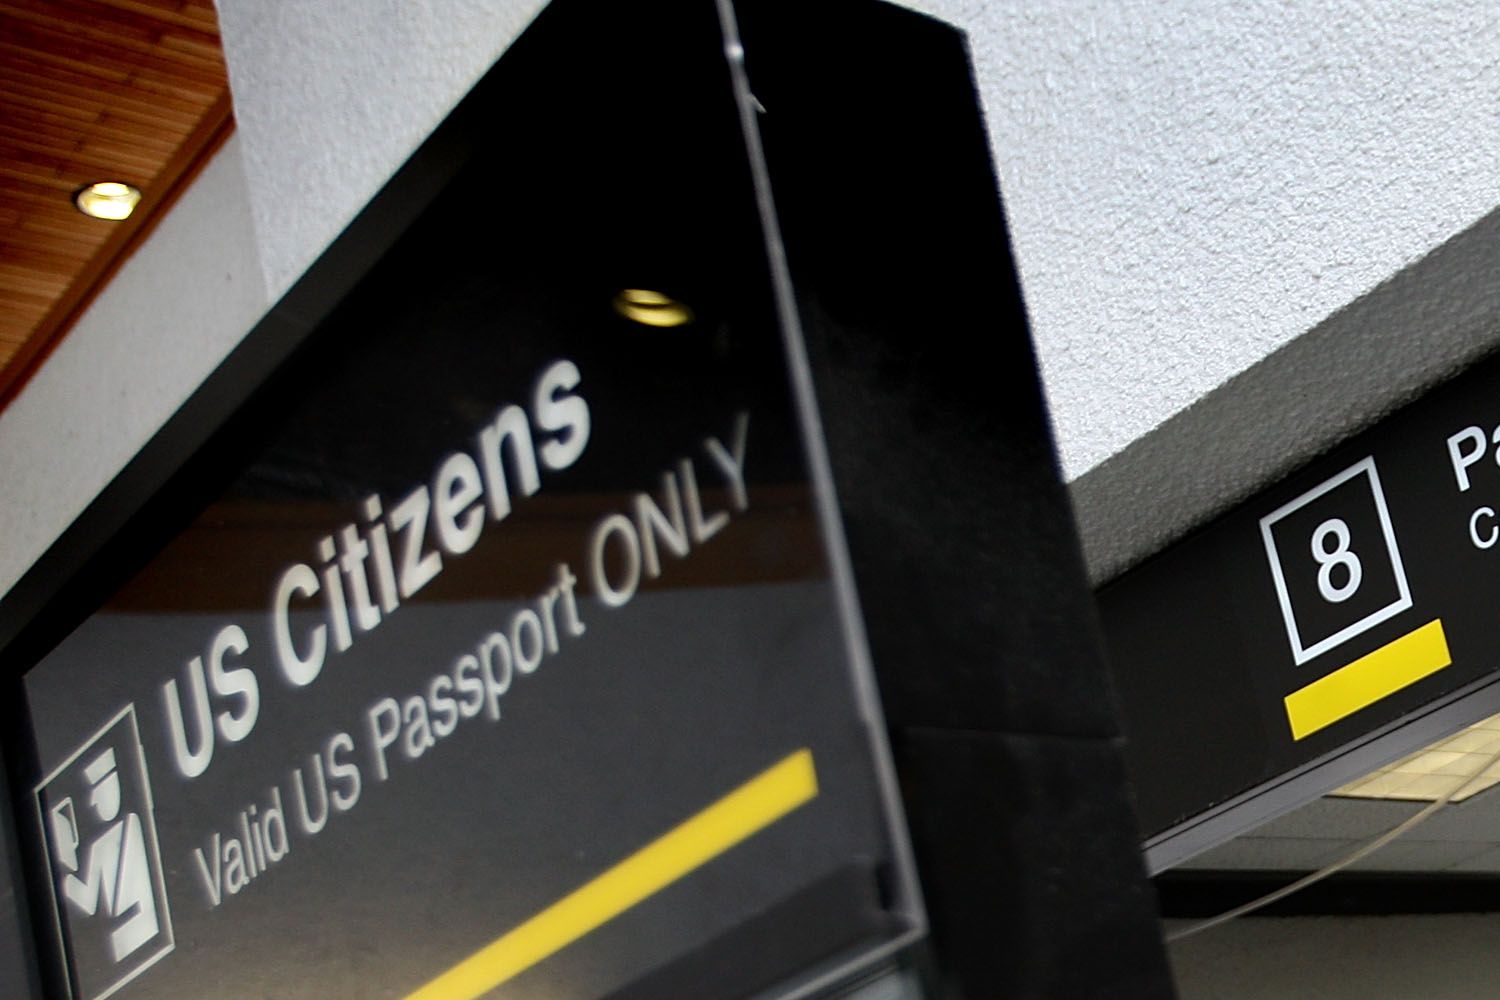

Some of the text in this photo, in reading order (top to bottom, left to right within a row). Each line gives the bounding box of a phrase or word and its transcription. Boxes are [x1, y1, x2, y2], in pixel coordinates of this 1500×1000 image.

[162, 359, 591, 779] US Citizens
[193, 411, 751, 908] Valid US Passport ONLY
[1311, 518, 1363, 603] 8
